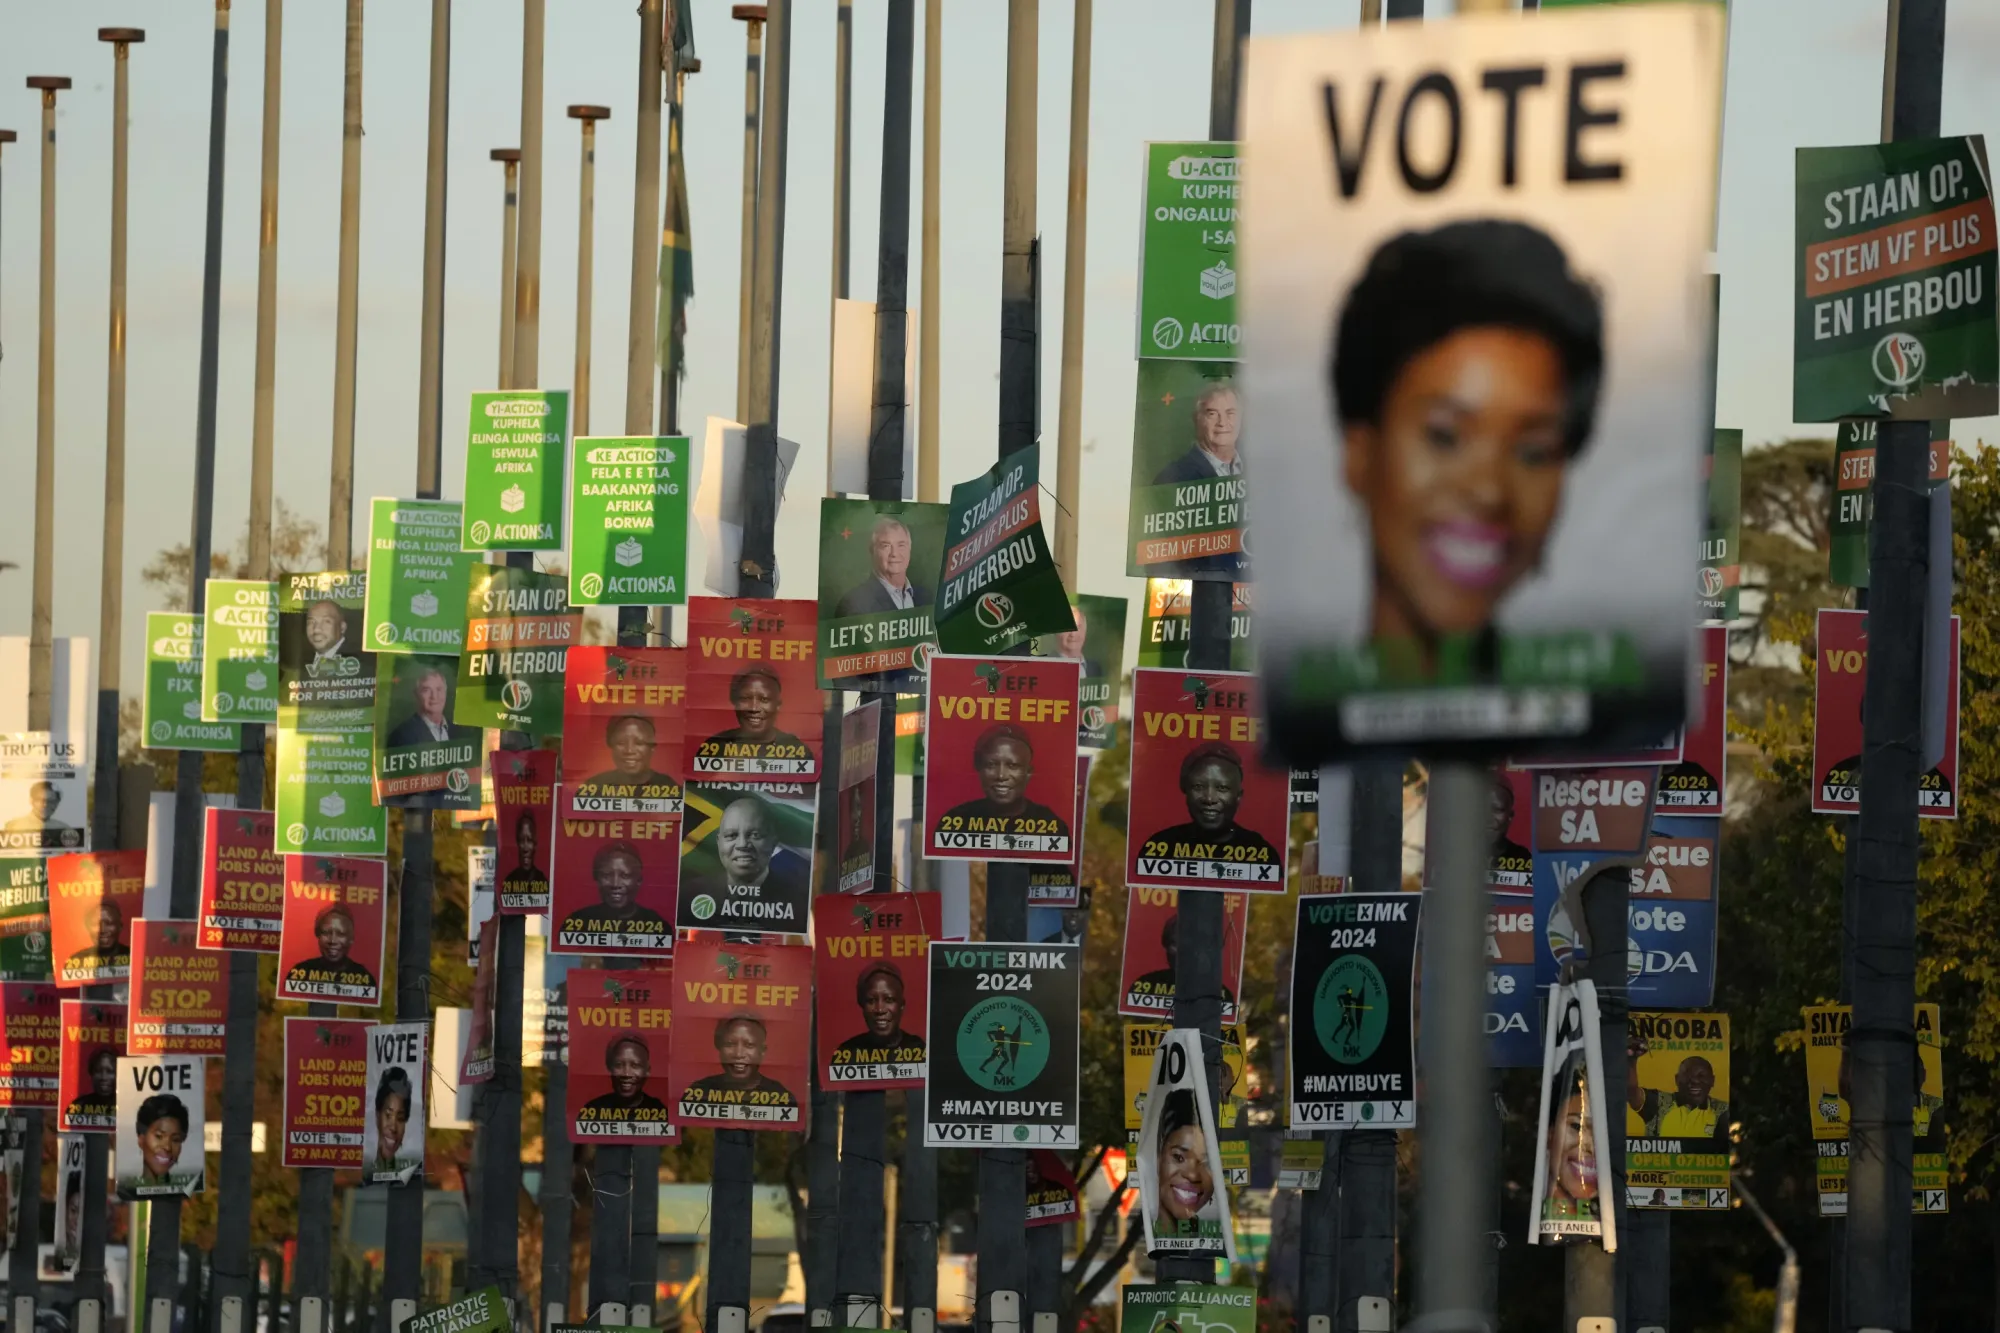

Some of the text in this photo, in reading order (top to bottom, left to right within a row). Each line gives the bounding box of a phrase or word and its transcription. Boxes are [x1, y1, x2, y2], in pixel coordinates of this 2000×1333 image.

[1322, 60, 1628, 199] VOTE
[1824, 159, 1968, 229] STAAN OP,
[1815, 214, 1980, 282] STEM VF PLUS
[1815, 265, 1982, 340] EN HERBOU
[1900, 342, 1916, 351] VF
[491, 403, 545, 415] YI-ACTION
[493, 419, 540, 429] KUPHELA
[472, 434, 560, 444] ELINGA LUNGISA
[492, 449, 538, 458] ISEWULA
[596, 451, 666, 461] KE ACTION
[495, 463, 533, 473] AFRIKA
[592, 467, 670, 479] FELA E E TLA
[582, 484, 678, 495] BAAKANYANG
[1176, 478, 1245, 507] KOM ONS
[606, 500, 654, 512] AFRIKA
[1840, 495, 1862, 523] EN
[604, 517, 654, 528] BORWA
[1144, 503, 1238, 534] HERSTEL EN
[400, 527, 455, 538] KUPHELA
[494, 524, 553, 540] ACTIONSA
[950, 500, 1028, 571] STEM PLUS
[376, 538, 420, 551] ELINGA
[1146, 535, 1231, 559] STEM VF PLUS!
[400, 554, 453, 566] ISEWULA
[404, 569, 448, 579] AFRIKA
[943, 535, 1036, 610] EN HERBOU
[608, 577, 675, 593] ACTIONSA
[292, 588, 364, 601] ALLIANCE
[482, 589, 538, 612] STAAN
[473, 622, 571, 642] STEM VF PLUS
[830, 625, 873, 648] LET'S
[985, 634, 1001, 646] VF
[228, 648, 256, 663] FIX
[700, 637, 813, 661] VOTE EFF
[469, 652, 566, 677] EN HERBOU
[865, 653, 906, 668] FF PLUS!
[289, 680, 328, 689] GAYTON
[289, 692, 312, 702] FOR
[577, 684, 636, 704] VOTE
[938, 696, 1070, 722] VOTE EFF
[1143, 712, 1220, 739] VOTE
[54, 743, 75, 756] US
[700, 743, 805, 757] 29 MAY 2024
[383, 745, 473, 773] LET'S REBUILD
[698, 758, 744, 771] VOTE
[388, 778, 419, 792] VOTE FF
[1668, 776, 1708, 789] 2024
[578, 784, 679, 798] 29 MAY 2024
[1539, 775, 1645, 808] Rescue
[577, 799, 622, 810] VOTE
[1560, 811, 1600, 843] SA
[313, 826, 376, 842] ACTIONSA
[940, 834, 991, 847] VOTE
[219, 846, 257, 859] LAND
[216, 860, 251, 873] JOBS
[1227, 869, 1244, 877] EFF
[10, 868, 31, 886] WE
[728, 885, 761, 896] VOTE
[721, 899, 794, 920] ACTIONSA
[1375, 903, 1408, 921] MK
[209, 917, 244, 928] VOTE
[566, 919, 663, 933] 29 MAY 2024
[227, 932, 257, 943] MAY
[564, 934, 607, 944] VOTE
[1331, 929, 1376, 948] 2024
[826, 936, 887, 958] VOTE
[146, 957, 218, 968] LAND AND
[1029, 952, 1066, 969] MK
[1645, 951, 1698, 973] DA
[144, 970, 219, 982] JOBS NOW!
[291, 969, 369, 985] 29 MAY 2024
[976, 974, 1032, 991] 2024
[289, 981, 324, 993] VOTE
[684, 982, 747, 1004] VOTE
[1134, 981, 1151, 992] 29
[150, 989, 211, 1008] STOP
[1132, 995, 1173, 1008] VOTE
[6, 1016, 39, 1025] LAND
[5, 1027, 33, 1038] JOBS
[138, 1025, 172, 1034] VOTE
[136, 1038, 221, 1049] 29 MAY 2024
[1651, 1041, 1691, 1050] 25 MAY
[1812, 1037, 1837, 1046] RALLY
[856, 1049, 890, 1062] MAY
[1343, 1047, 1361, 1057] MK
[300, 1059, 365, 1072] LAND AND
[133, 1064, 191, 1091] VOTE
[298, 1073, 329, 1085] JOBS
[833, 1066, 877, 1079] VOTE
[993, 1076, 1015, 1086] MK
[1304, 1074, 1401, 1093] #MAYIBUYE
[305, 1095, 360, 1116] STOP
[683, 1104, 728, 1117] VOTE
[942, 1101, 1062, 1116] #MAYIBUYE
[1299, 1103, 1344, 1120] VOTE
[580, 1108, 667, 1120] 29 MAY 2024
[580, 1122, 618, 1133] VOTE
[935, 1125, 992, 1140] VOTE
[293, 1133, 326, 1143] VOTE
[292, 1148, 338, 1160] 29 MAY
[1818, 1142, 1836, 1156] FNB
[1632, 1155, 1726, 1167] OPEN 07H00
[1632, 1174, 1666, 1185] MORE,
[1820, 1179, 1838, 1189] LET'S
[1566, 1223, 1596, 1232] ANELE
[1127, 1291, 1252, 1306] PATRIOTIC ALLIANCE
[411, 1293, 488, 1333] PATRIOTIC
